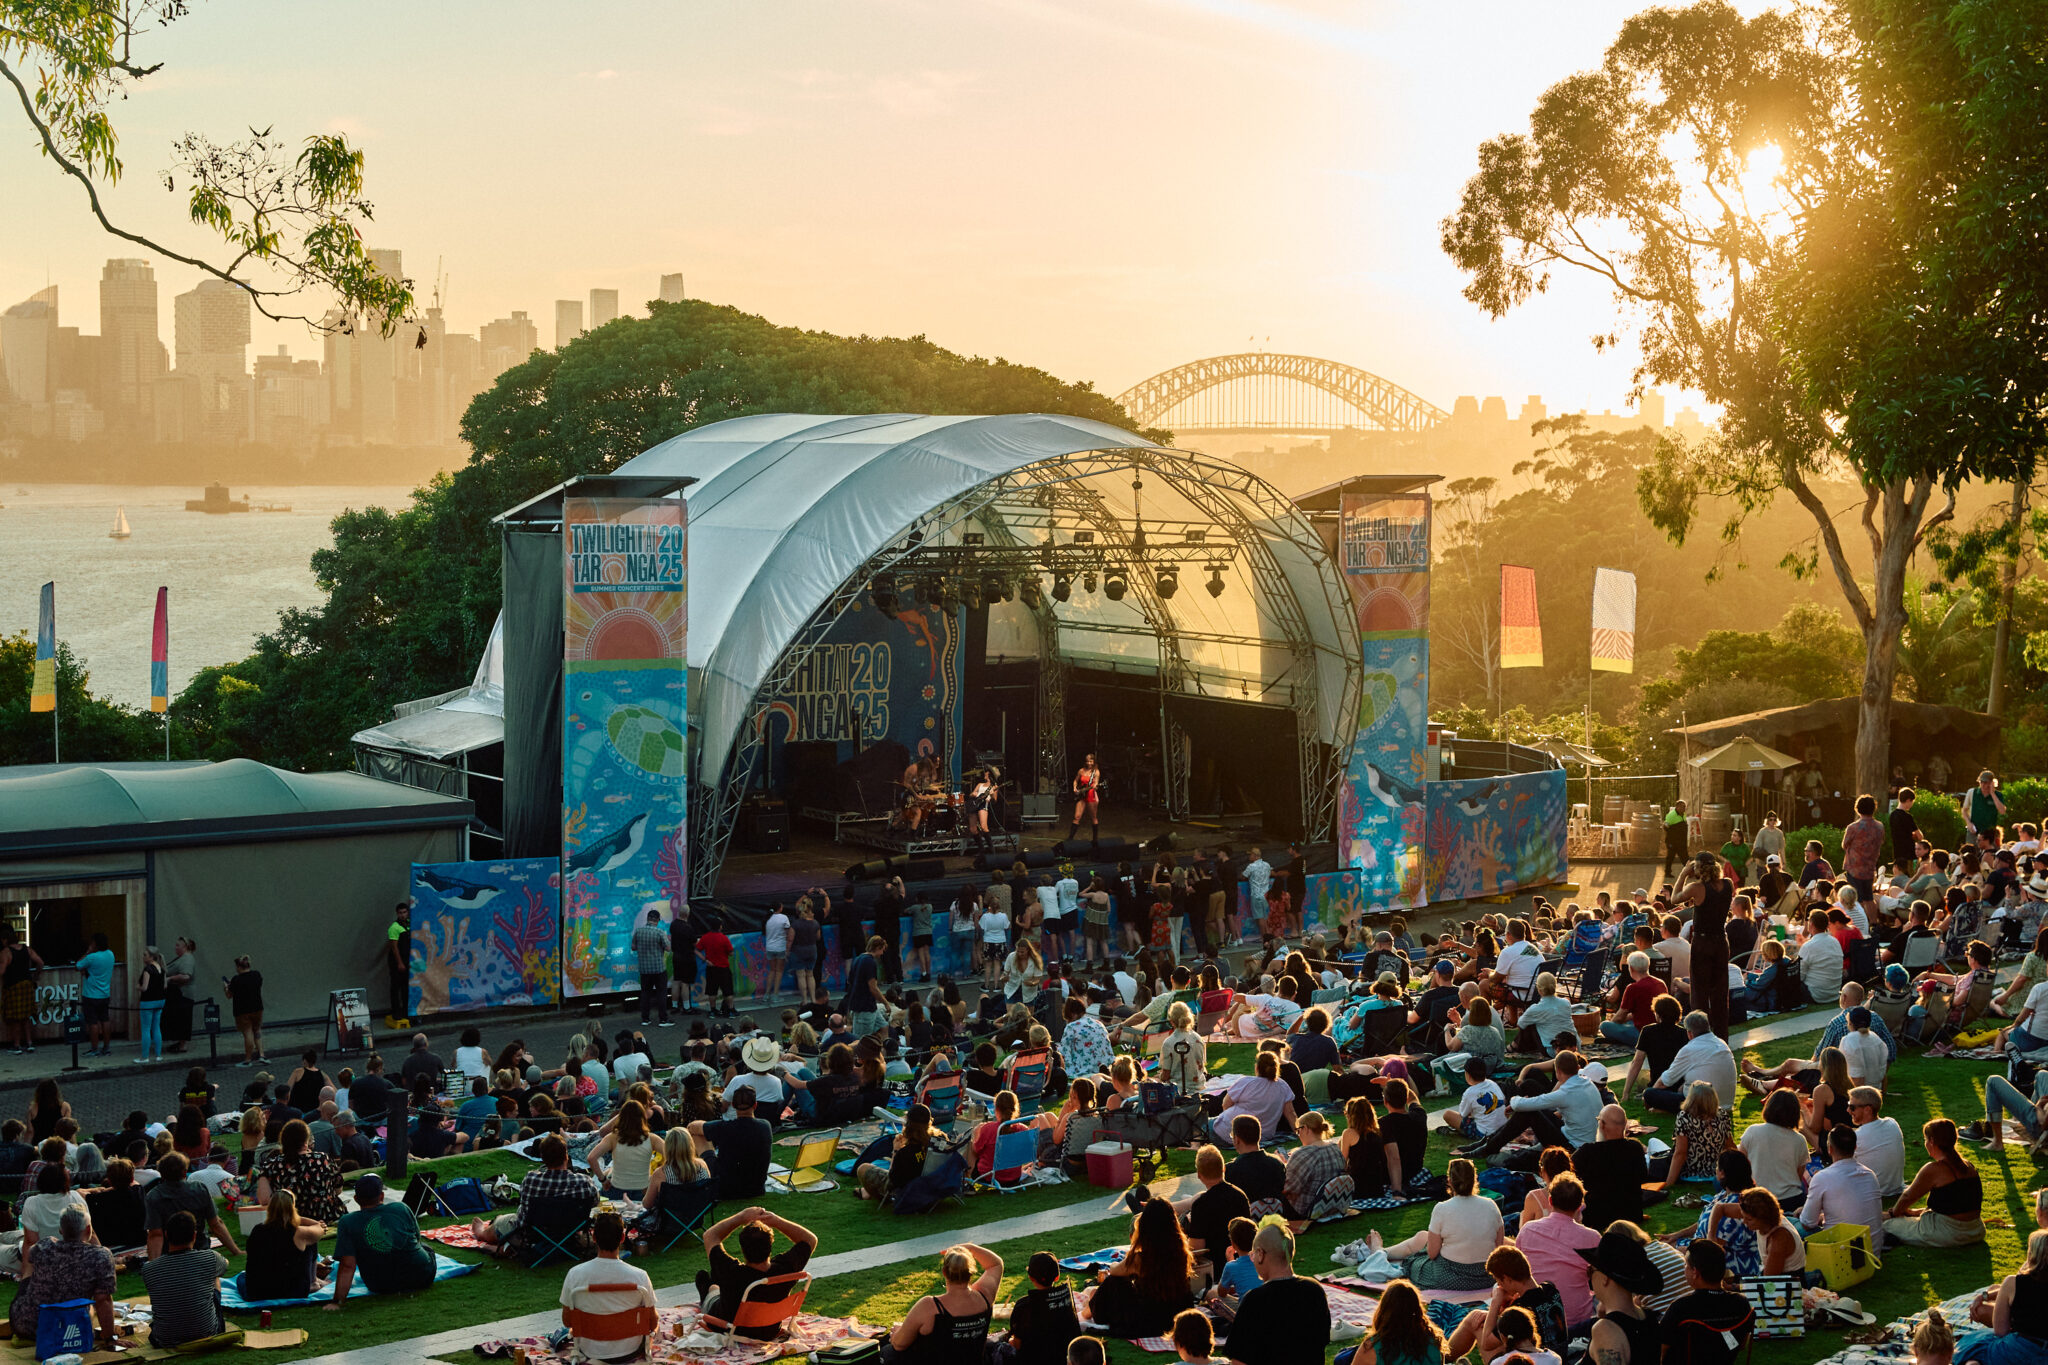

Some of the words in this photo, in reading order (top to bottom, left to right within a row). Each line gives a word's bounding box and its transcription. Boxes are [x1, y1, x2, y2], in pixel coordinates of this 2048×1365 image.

[571, 525, 644, 553] TWILIGHT
[645, 526, 657, 553] AT
[658, 525, 683, 554] 20
[1345, 517, 1399, 541] TWILIGHT
[1410, 517, 1427, 542] 20
[1410, 541, 1427, 566] 25
[571, 554, 658, 583] TARONGA
[659, 554, 683, 583] 25
[833, 645, 852, 692] AT
[852, 642, 891, 691] 20
[62, 1339, 82, 1348] ALDI
